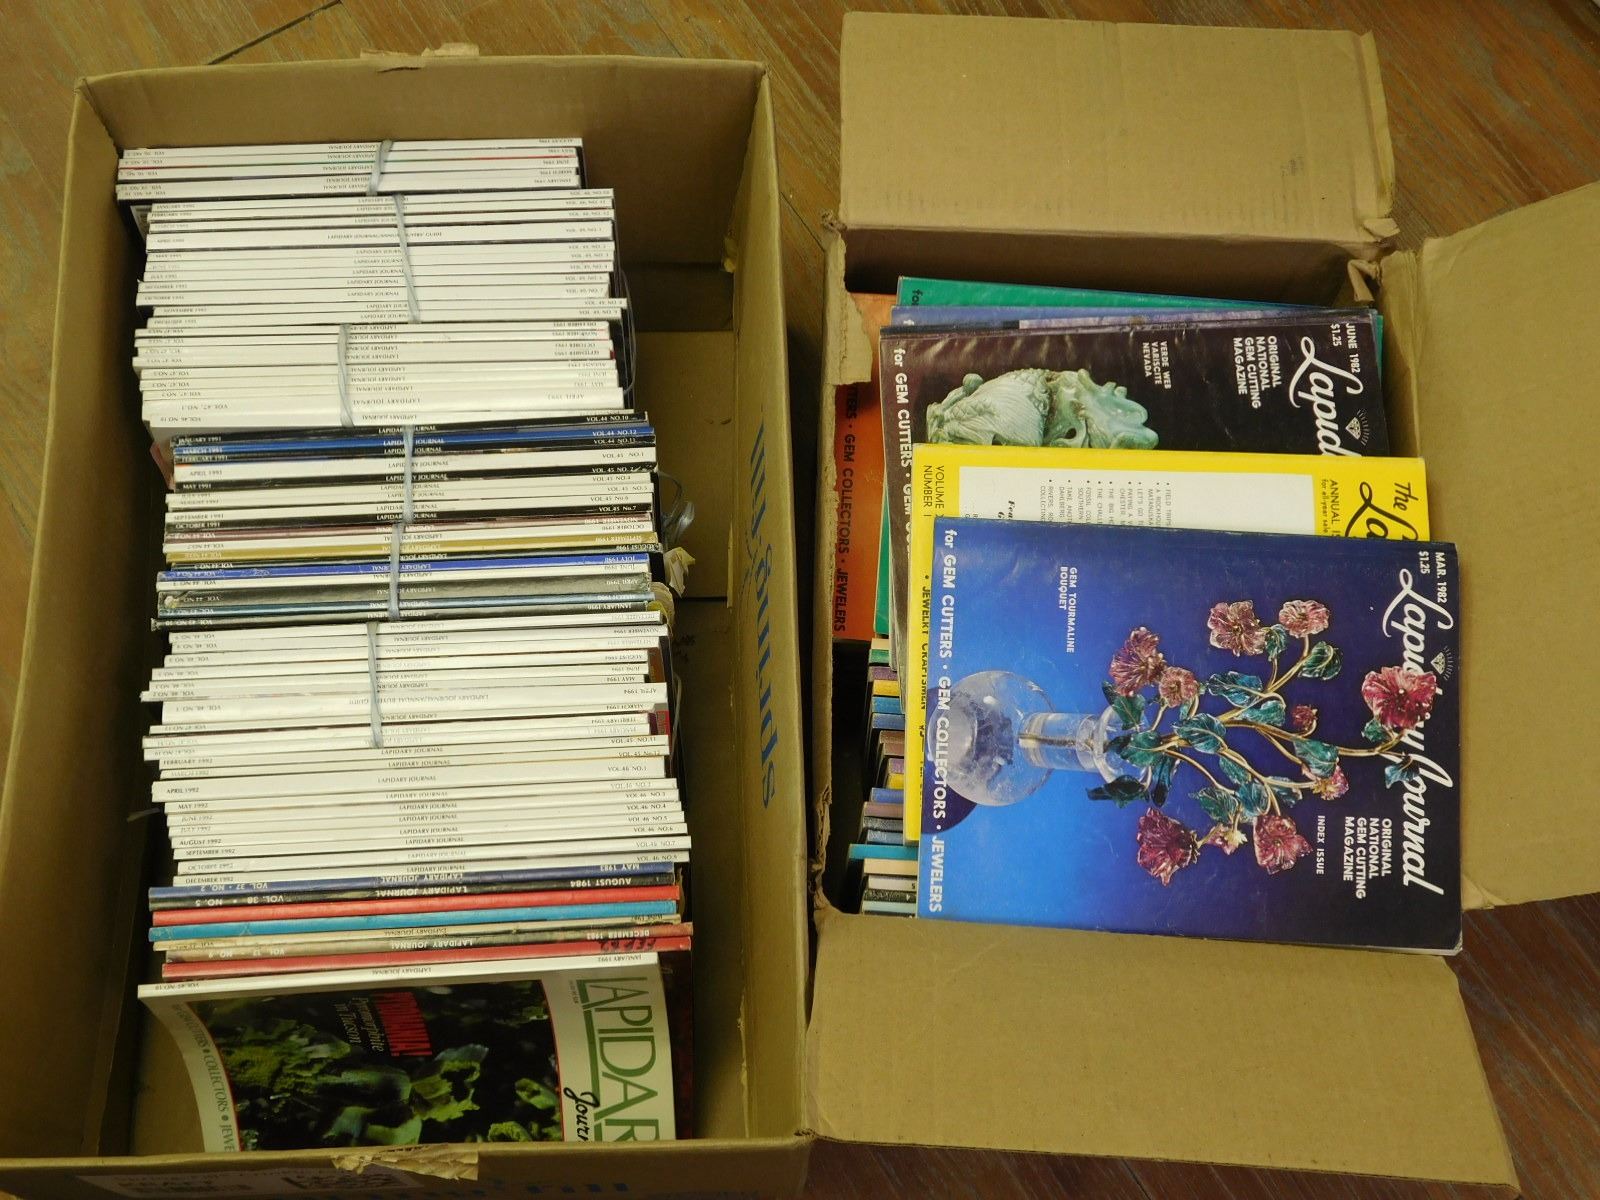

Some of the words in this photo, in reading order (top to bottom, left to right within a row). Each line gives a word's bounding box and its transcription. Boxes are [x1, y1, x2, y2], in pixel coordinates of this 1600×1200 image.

[1245, 337, 1255, 361] GEM
[1330, 324, 1342, 346] $1.25
[1345, 323, 1357, 349] JUNE
[894, 348, 906, 366] for
[1142, 342, 1151, 377] NEVADA
[1151, 342, 1162, 384] VARISCITE
[1160, 341, 1170, 367] VERDE
[1233, 338, 1247, 395] MAGAZINE
[1256, 336, 1270, 390] NATIONAL
[1268, 336, 1281, 387] ORIGINAL
[1350, 354, 1361, 373] 1982
[895, 373, 908, 403] GEM
[1163, 371, 1171, 389] WEB
[1247, 364, 1261, 408] CUTTING
[844, 434, 856, 462] GEM
[899, 410, 912, 468] CUTTERS
[924, 465, 932, 507] NUMBER
[935, 465, 944, 509] VOLUME
[1321, 479, 1329, 489] for
[1393, 483, 1418, 510] The
[838, 469, 854, 553] COLLECTORS
[1330, 480, 1340, 524] ANNUAL
[944, 529, 957, 548] for
[943, 555, 957, 588] GEM
[1069, 567, 1078, 587] GEM
[1418, 551, 1430, 574] $1.25
[1435, 552, 1447, 578] MAR.
[834, 568, 849, 632] JEWELERS
[1058, 566, 1068, 610] BOUQUET
[1436, 581, 1449, 603] 1982
[940, 595, 955, 658] CUTTERS
[1066, 593, 1077, 653] TOURMALINE
[937, 676, 951, 709] GEM
[932, 717, 950, 819] COLLECTORS
[1316, 815, 1326, 845] INDEX
[1355, 817, 1367, 845] GEM
[1315, 849, 1325, 875] ISSUE
[1342, 816, 1355, 881] MAGAZINE
[1368, 818, 1379, 879] NATIONAL
[1380, 818, 1392, 876] ORIGINAL
[382, 875, 419, 883] JOURNAL
[595, 878, 631, 886] AUGUST
[928, 835, 945, 912] JEWELERS
[1354, 847, 1366, 899] CUTTING
[376, 889, 419, 897] JOURNAL
[422, 886, 466, 894] LAPIDARY
[432, 939, 472, 947] LAPIDARY
[608, 930, 649, 938] DECEMBER
[339, 1013, 361, 1043] Tucson
[203, 1055, 229, 1112] COLLECTORS
